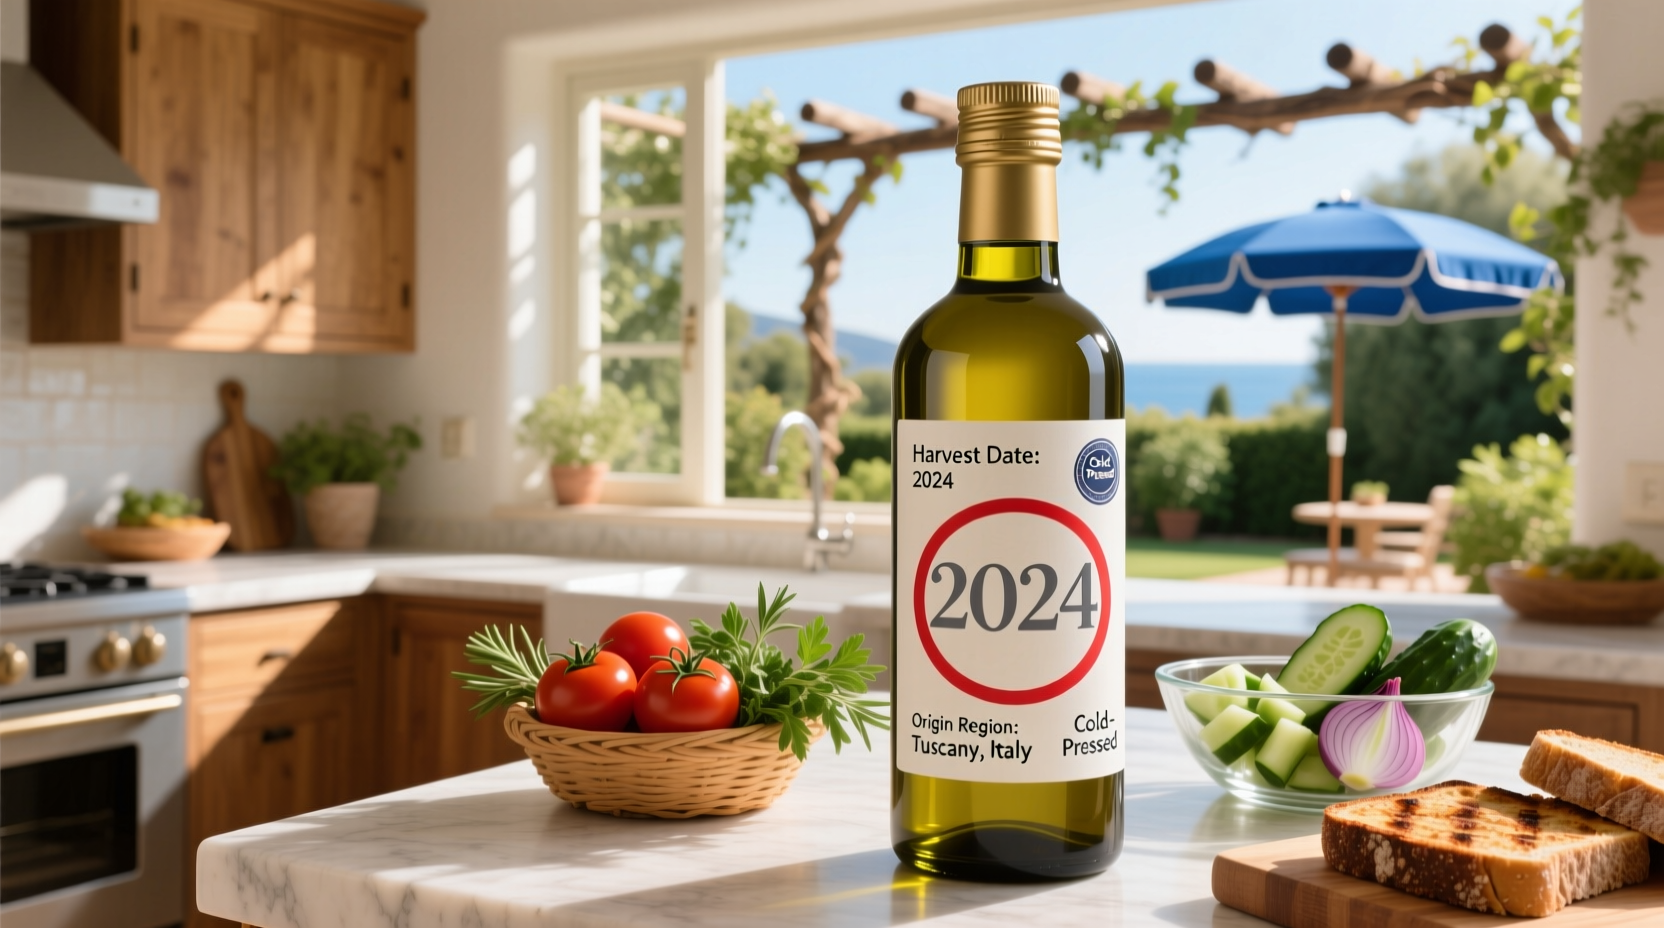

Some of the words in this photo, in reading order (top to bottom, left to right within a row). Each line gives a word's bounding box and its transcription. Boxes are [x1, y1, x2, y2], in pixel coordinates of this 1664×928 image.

[913, 443, 981, 465] Harvest
[987, 446, 1040, 465] Date:
[912, 471, 954, 489] 2024
[929, 562, 1098, 632] 2024
[911, 713, 953, 735] Origin
[958, 717, 1019, 738] Region:
[1074, 710, 1115, 733] Cold-
[911, 735, 985, 763] Tuscany,
[990, 740, 1033, 765] Italy
[1062, 731, 1118, 757] Pressed
